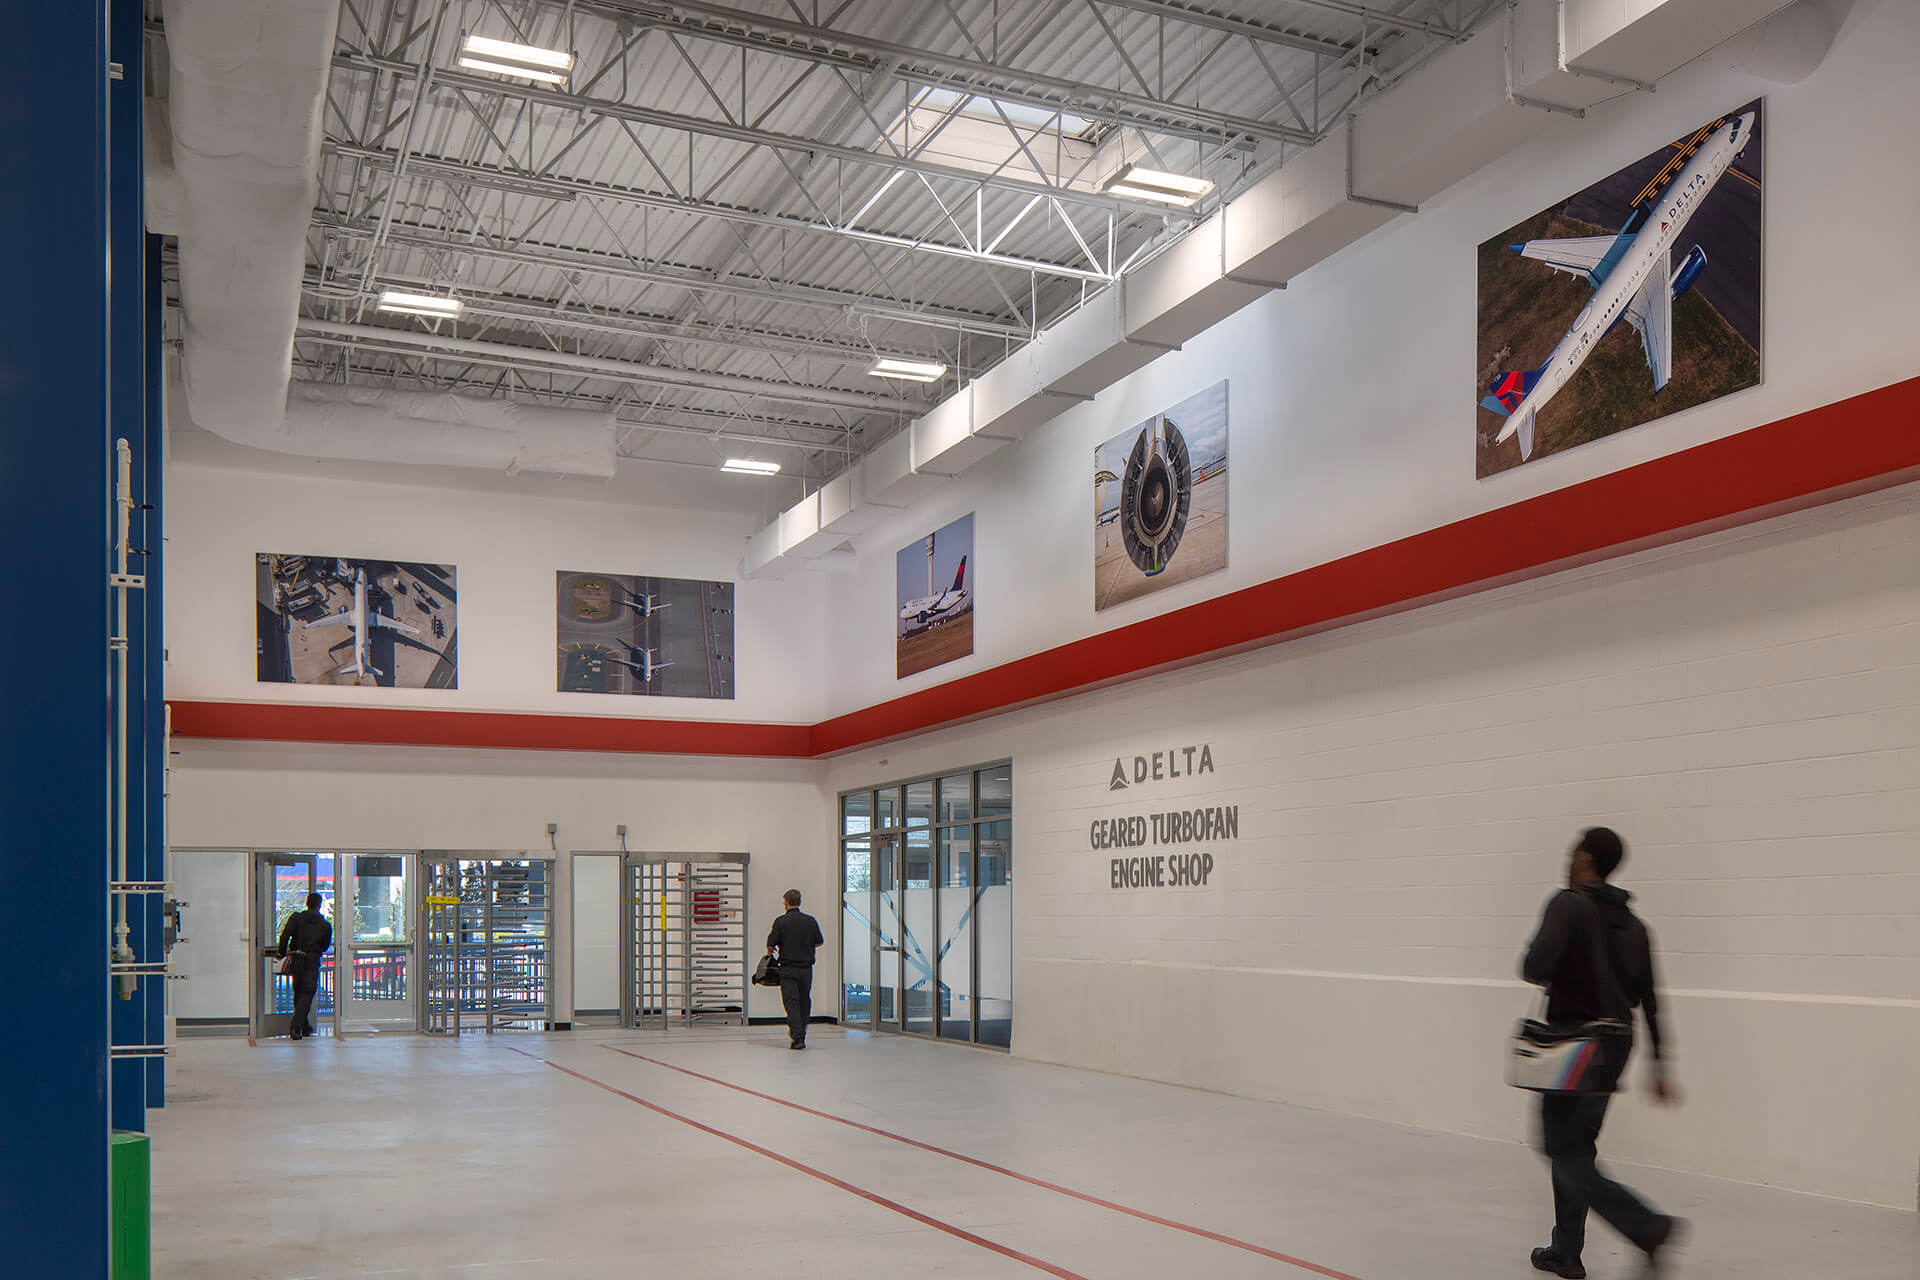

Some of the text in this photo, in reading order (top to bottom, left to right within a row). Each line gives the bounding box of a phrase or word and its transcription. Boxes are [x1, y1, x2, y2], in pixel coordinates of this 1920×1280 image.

[1668, 174, 1703, 218] DELTA
[1134, 744, 1215, 784] DELTA
[1090, 806, 1239, 850] GEARED TURBOFAN
[1111, 853, 1214, 889] ENGINE SHOP
